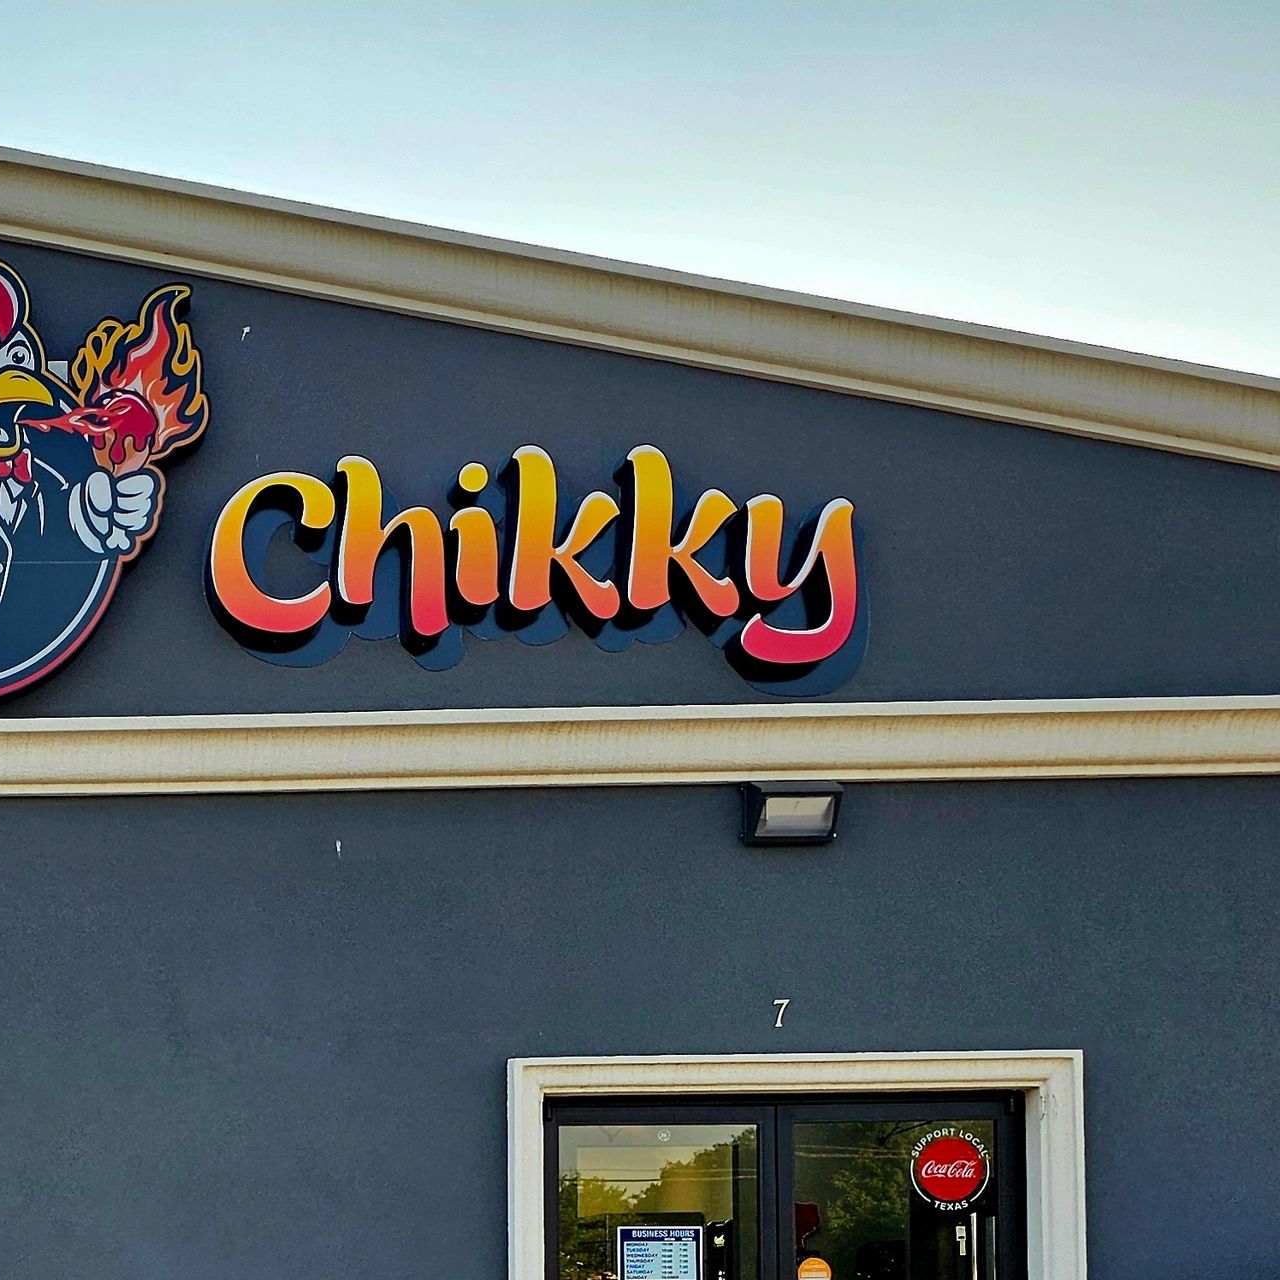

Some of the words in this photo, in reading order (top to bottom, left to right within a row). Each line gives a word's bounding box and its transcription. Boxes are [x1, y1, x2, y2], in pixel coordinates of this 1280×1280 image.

[210, 444, 855, 664] Chikky
[773, 999, 790, 1028] 7
[911, 1127, 955, 1158] SUPPORT
[959, 1129, 988, 1157] LOCAL
[934, 1200, 969, 1211] TEXAS
[632, 1230, 668, 1238] BUSINESS
[669, 1230, 695, 1238] HOURS
